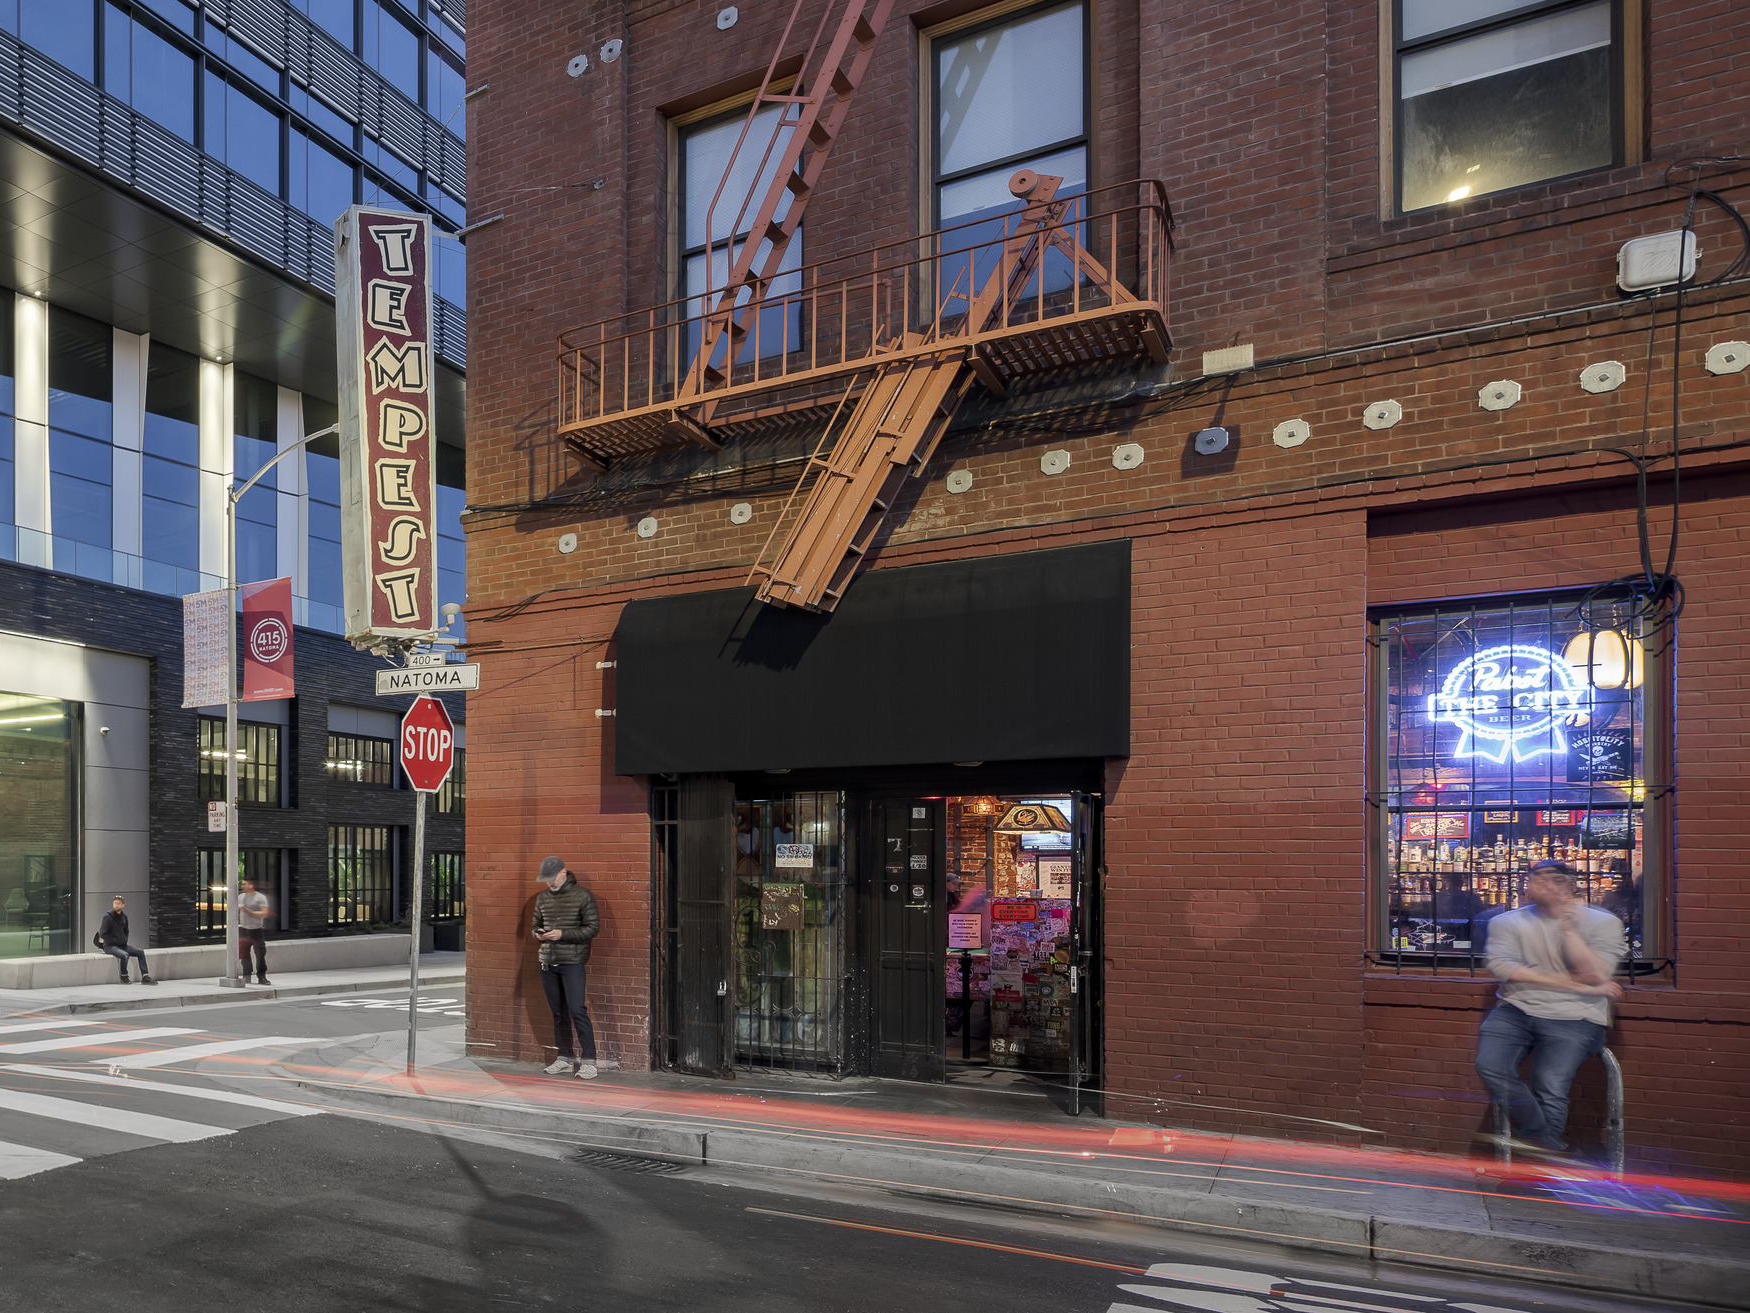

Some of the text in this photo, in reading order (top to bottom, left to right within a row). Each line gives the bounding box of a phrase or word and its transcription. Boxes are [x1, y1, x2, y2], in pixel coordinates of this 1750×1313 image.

[367, 223, 428, 625] TEMPEST
[258, 631, 280, 645] 415
[412, 656, 430, 665] 400
[390, 671, 461, 688] NATOMA
[1468, 662, 1551, 691] Pabst
[1439, 691, 1584, 716] THE CITY
[1489, 715, 1531, 723] BEER
[404, 725, 450, 762] STOP
